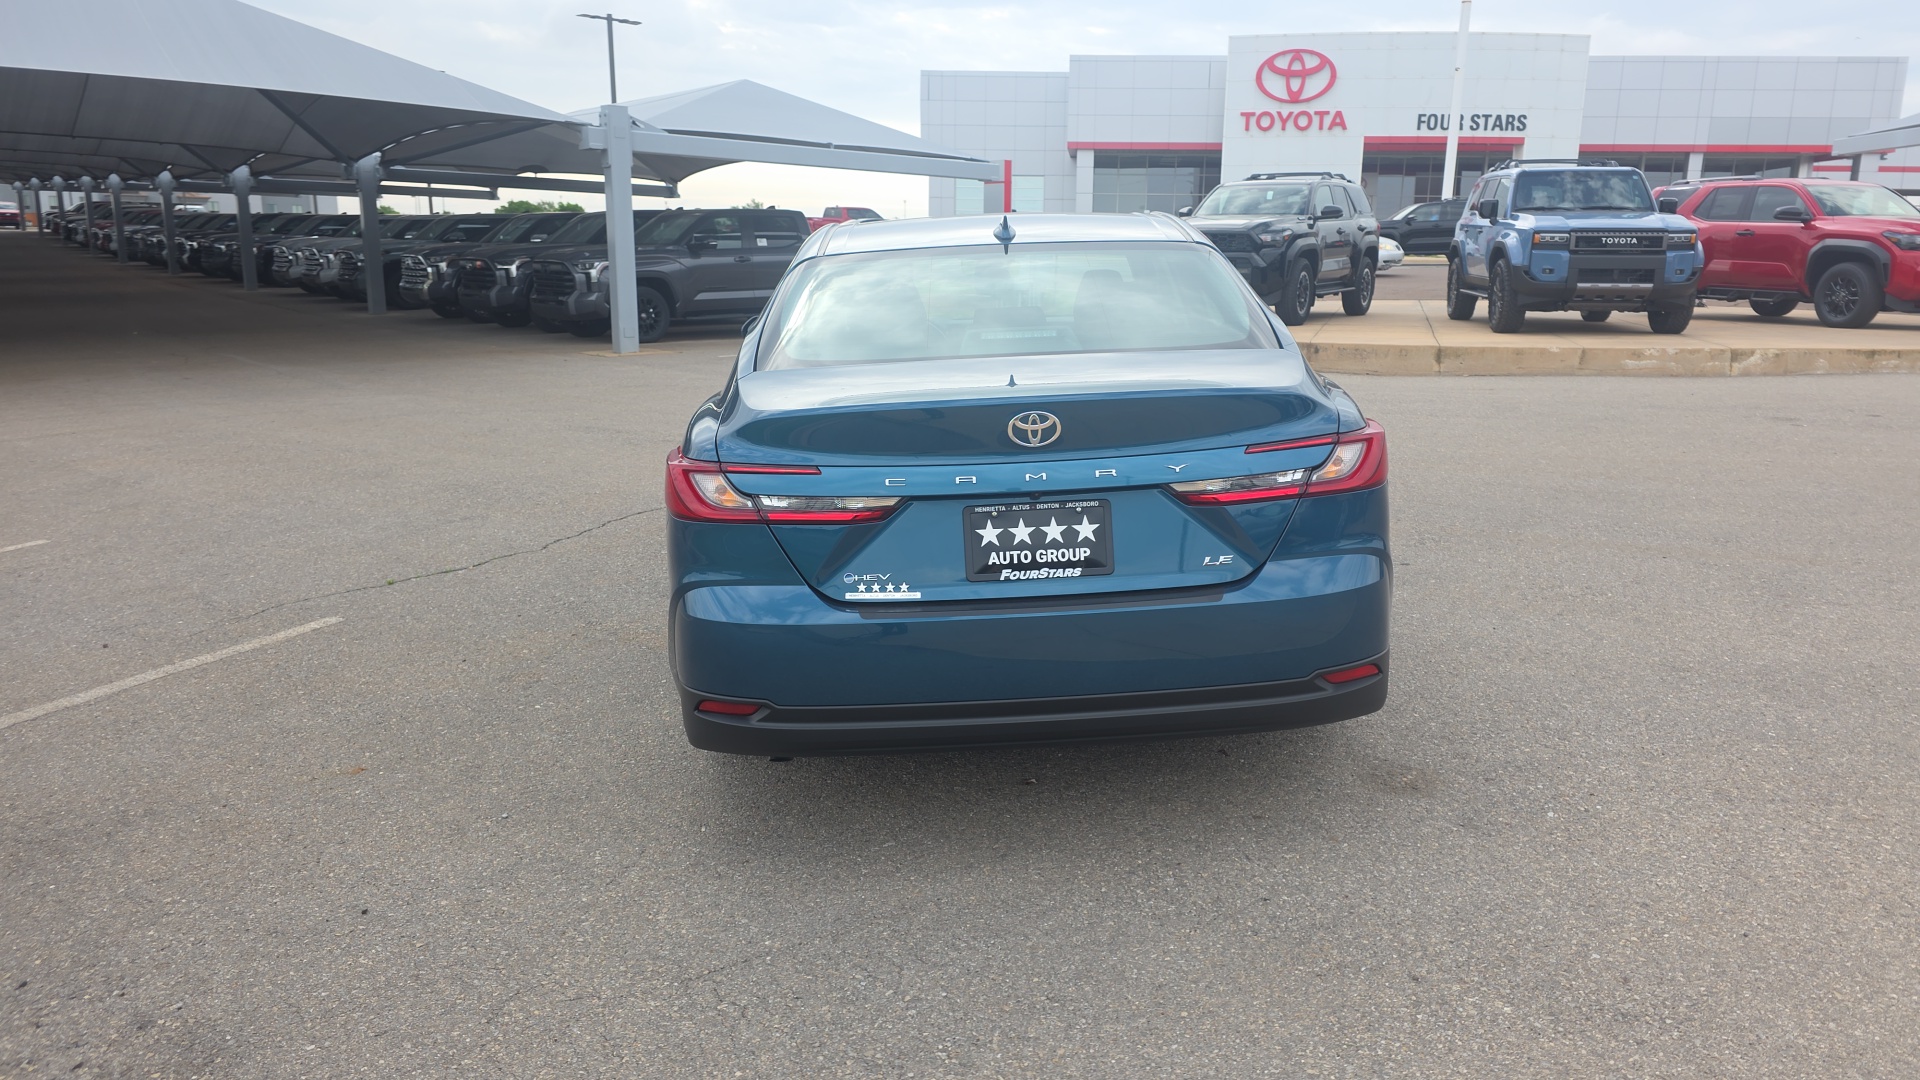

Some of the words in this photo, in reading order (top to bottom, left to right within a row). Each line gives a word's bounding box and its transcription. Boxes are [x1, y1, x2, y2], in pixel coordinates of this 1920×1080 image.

[1240, 110, 1348, 132] TOYOTA
[1469, 113, 1528, 132] STARS
[885, 463, 1190, 486] CAMRY
[988, 550, 1032, 565] AUTO
[1035, 547, 1091, 563] GROUP
[1202, 555, 1234, 566] LE
